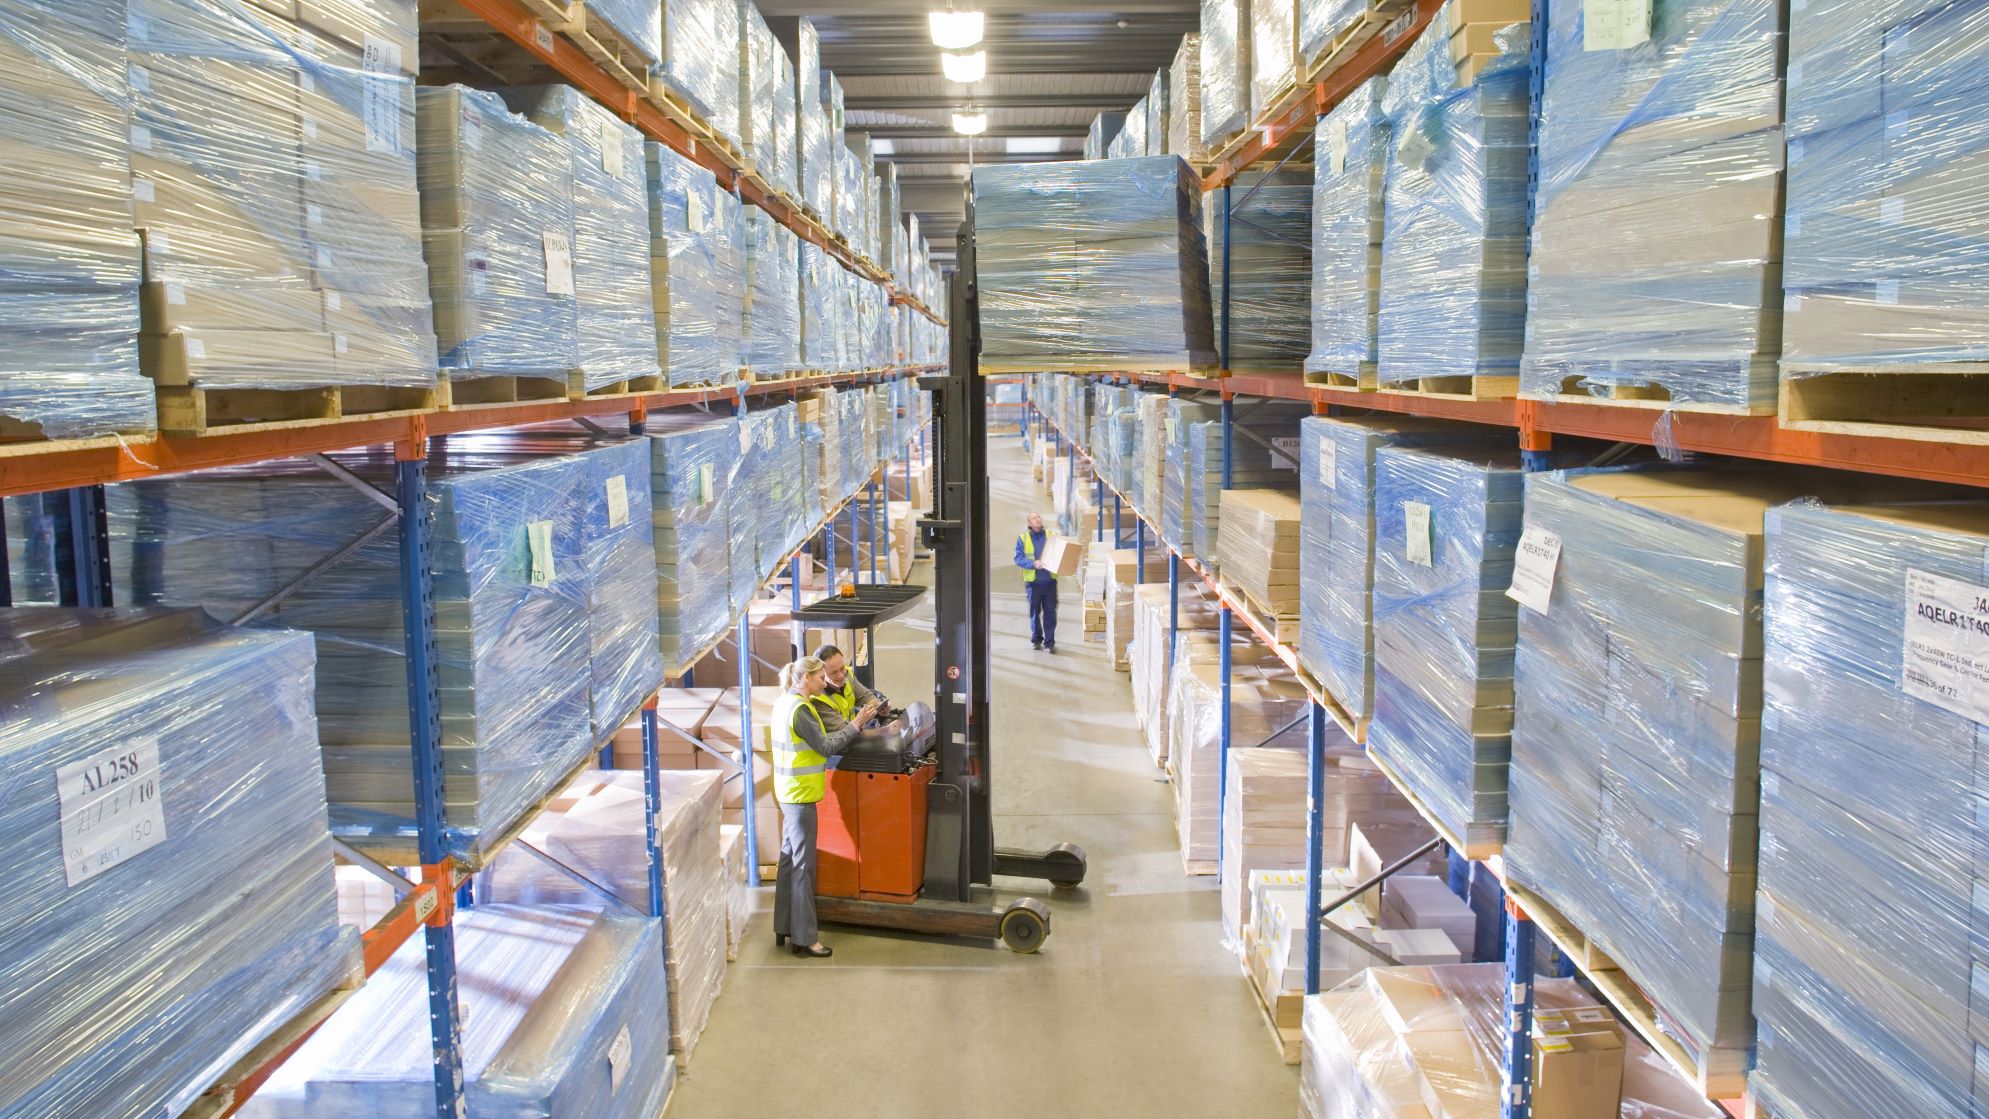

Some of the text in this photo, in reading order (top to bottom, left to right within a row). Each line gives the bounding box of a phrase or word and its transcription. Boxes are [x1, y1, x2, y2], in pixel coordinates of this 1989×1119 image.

[1973, 597, 1989, 614] JA
[1912, 650, 1939, 666] Frequency
[1938, 685, 1946, 694] of
[1947, 687, 1958, 697] 72
[81, 752, 139, 796] AL258
